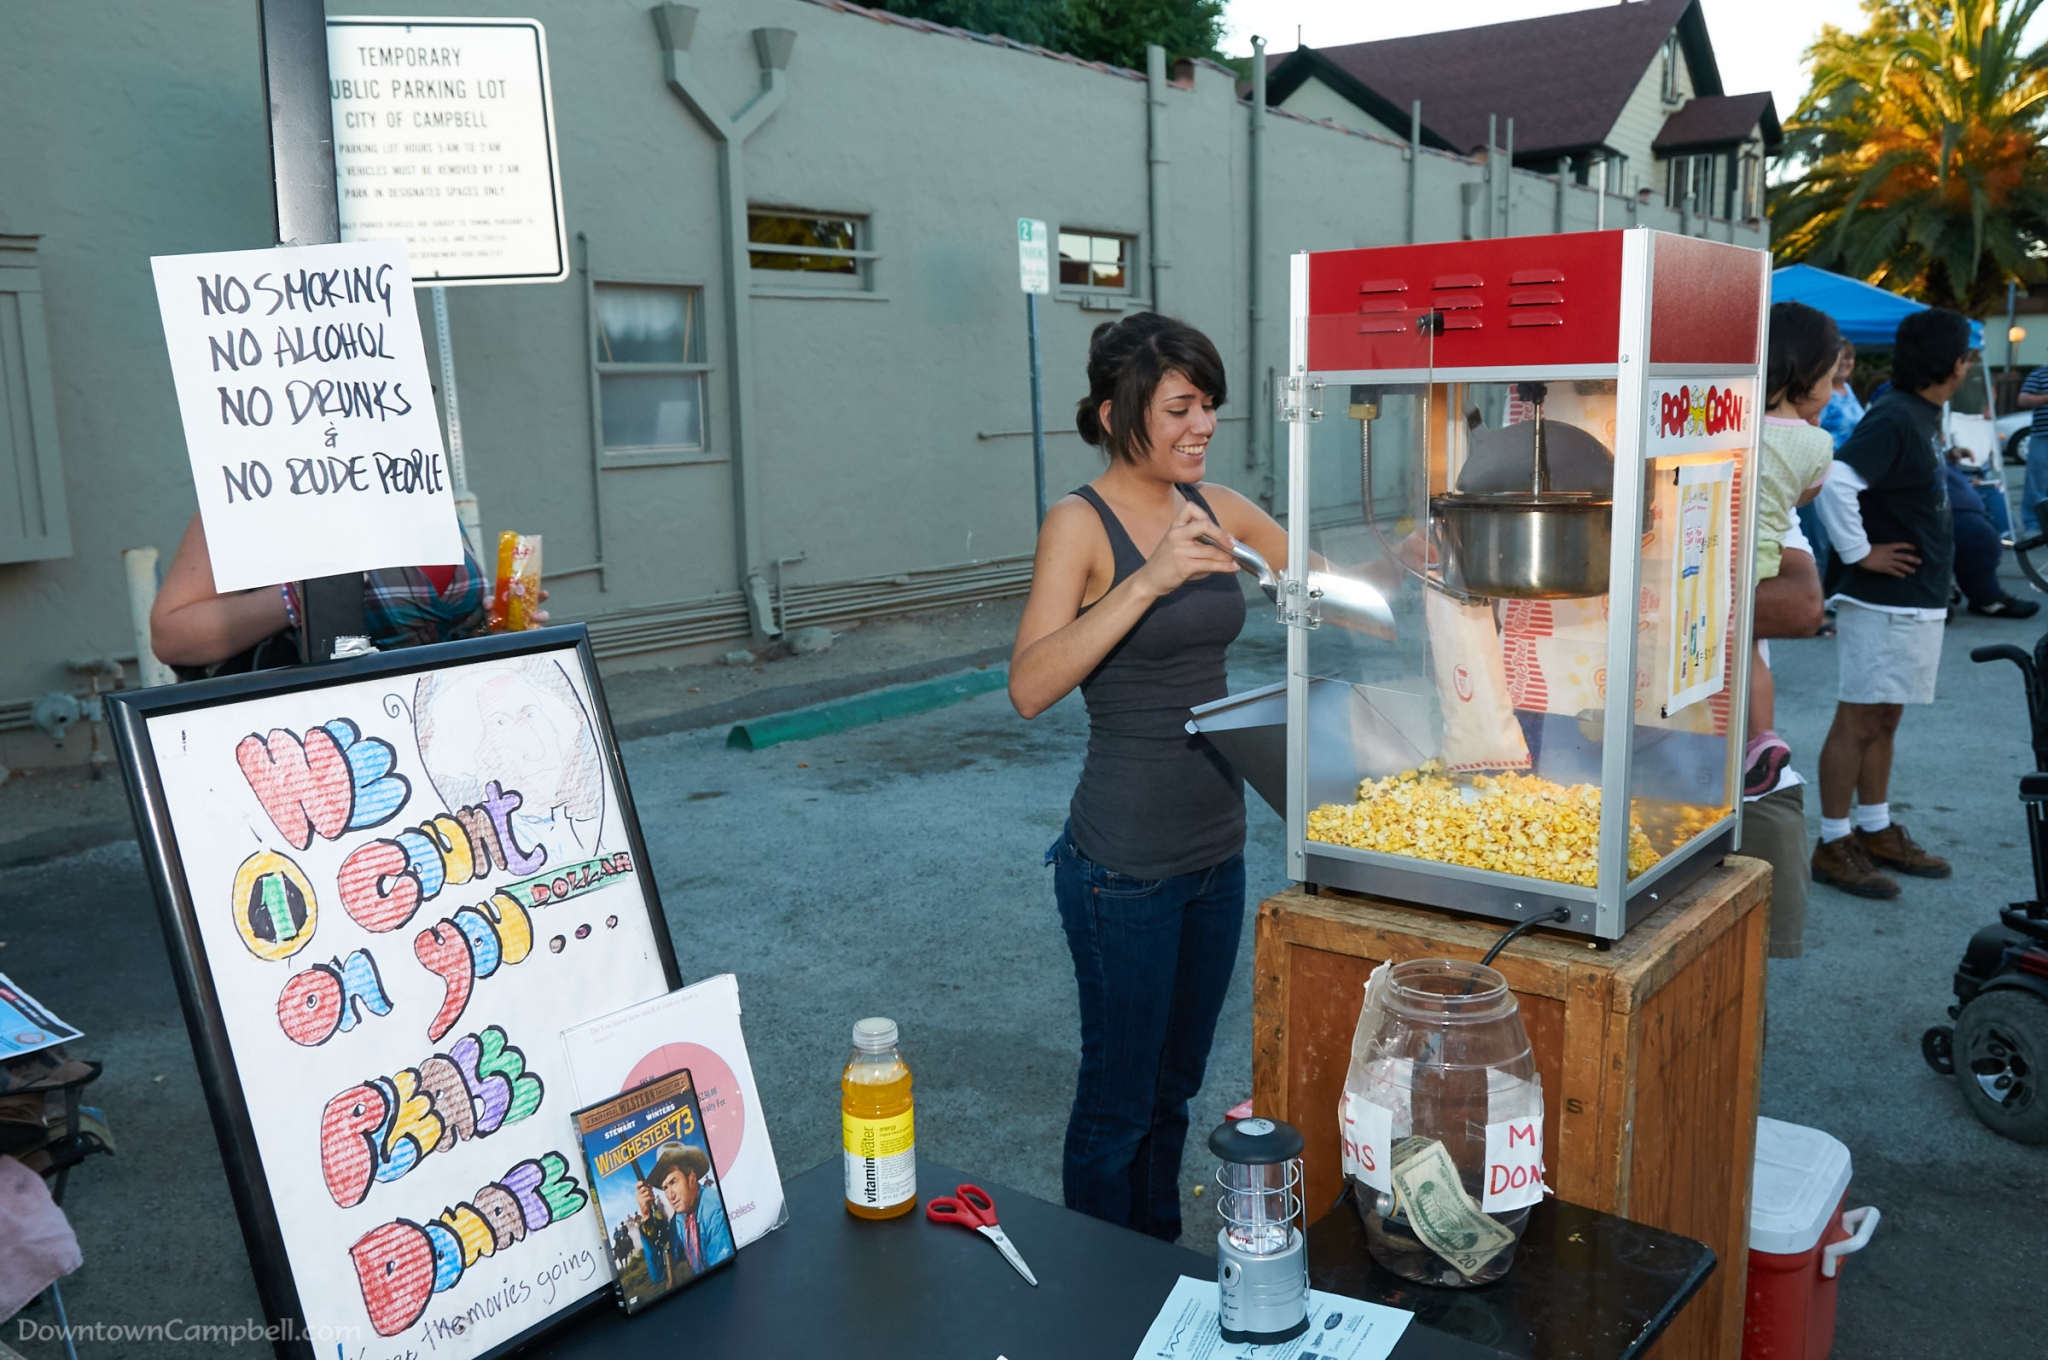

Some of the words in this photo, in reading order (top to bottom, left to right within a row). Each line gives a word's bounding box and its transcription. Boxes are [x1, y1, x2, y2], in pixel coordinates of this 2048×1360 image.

[358, 47, 461, 67] TEMPORARY
[330, 79, 380, 100] UBLIC
[391, 79, 467, 100] PARKING
[478, 79, 507, 99] LOT
[346, 111, 377, 128] CITY
[386, 111, 402, 128] OF
[413, 111, 488, 128] CAMPBELL
[338, 143, 378, 154] PARKING
[382, 142, 399, 153] LOT
[345, 165, 387, 176] VEHICLES
[392, 165, 416, 176] MUST
[344, 188, 368, 198] PARK
[388, 187, 440, 197] DESIGNATED
[1021, 222, 1031, 240] 2
[197, 273, 251, 316] NO
[253, 263, 393, 318] SMOKING
[208, 327, 263, 372] NO
[273, 322, 395, 368] ALCOHOL
[217, 385, 273, 427] NO
[285, 378, 412, 426] DRUNKS
[221, 460, 273, 504] NO
[285, 455, 370, 496] RUDE
[372, 448, 444, 496] PEOPLE
[236, 717, 411, 851] WE
[529, 851, 634, 905] DOLLAR
[618, 1088, 656, 1114] WESTERN
[700, 1101, 717, 1116] oyalty
[716, 1098, 727, 1108] Fee
[646, 1103, 676, 1121] WINTERS
[604, 1120, 636, 1139] STEWART
[863, 1126, 877, 1203] vitaminwater
[728, 1200, 756, 1222] iceless
[1457, 1254, 1478, 1270] 20
[421, 1315, 466, 1350] the
[466, 1277, 531, 1325] movies
[537, 1247, 597, 1305] going
